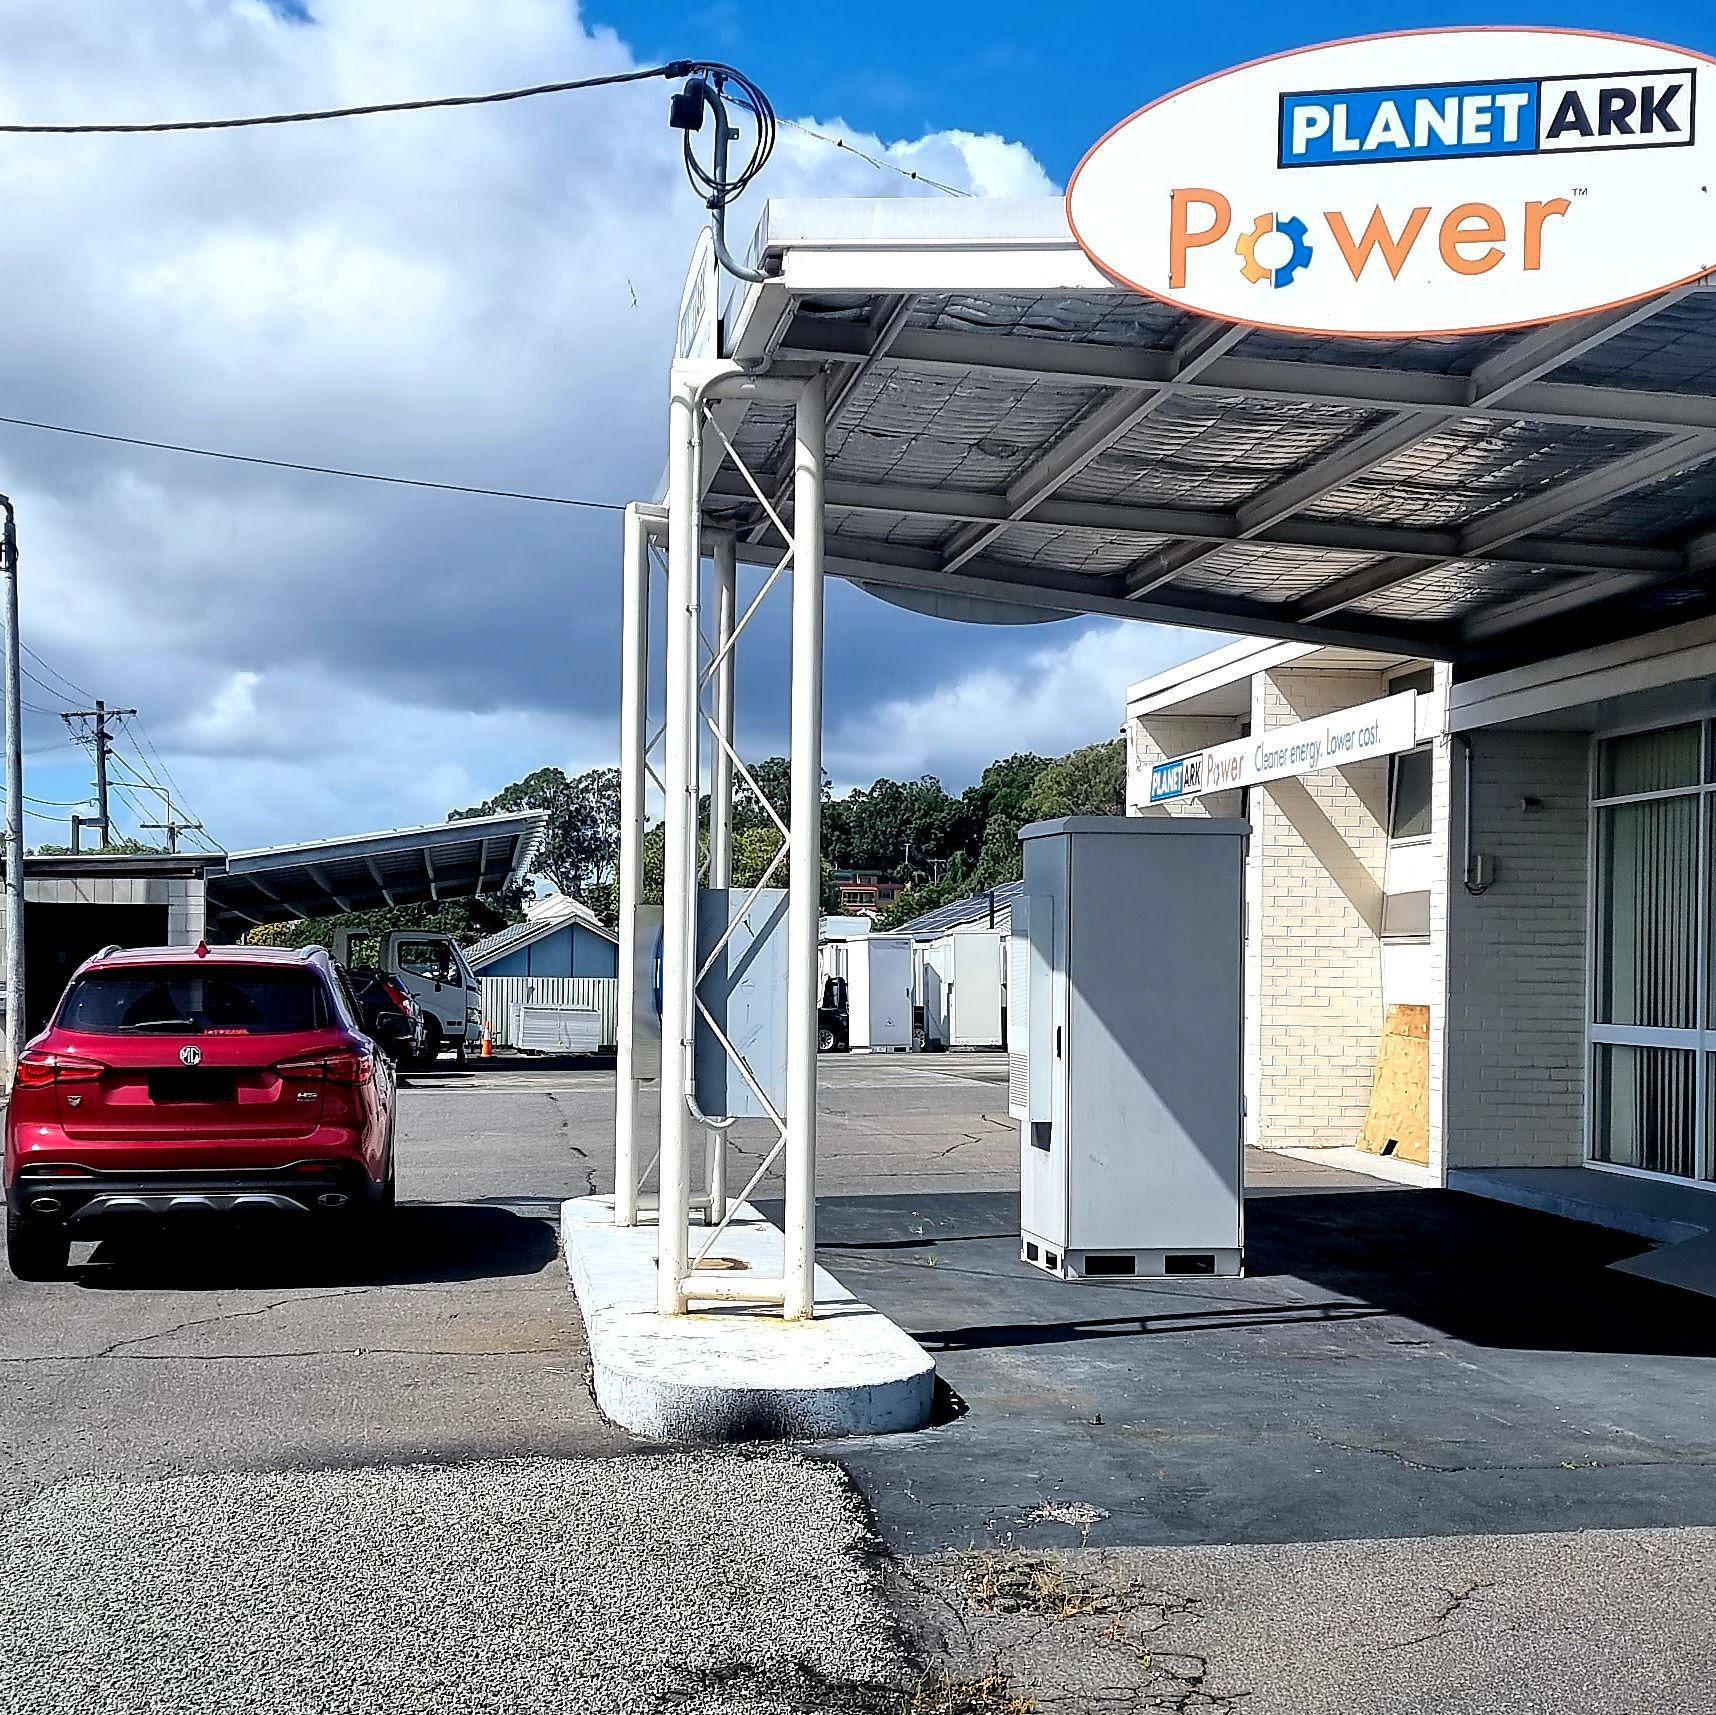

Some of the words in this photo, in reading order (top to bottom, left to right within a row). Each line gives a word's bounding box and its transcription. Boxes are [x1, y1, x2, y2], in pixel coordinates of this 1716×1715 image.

[1292, 93, 1529, 155] PLANET
[1545, 84, 1685, 140] ARK
[1152, 766, 1183, 796] PLANET
[1184, 760, 1202, 788] ARK
[1206, 753, 1245, 788] Power
[1254, 741, 1288, 772] Cleaner
[1290, 740, 1323, 769] energy.
[1326, 727, 1356, 756] Lower
[1358, 718, 1381, 748] cost.
[181, 1046, 201, 1065] MG
